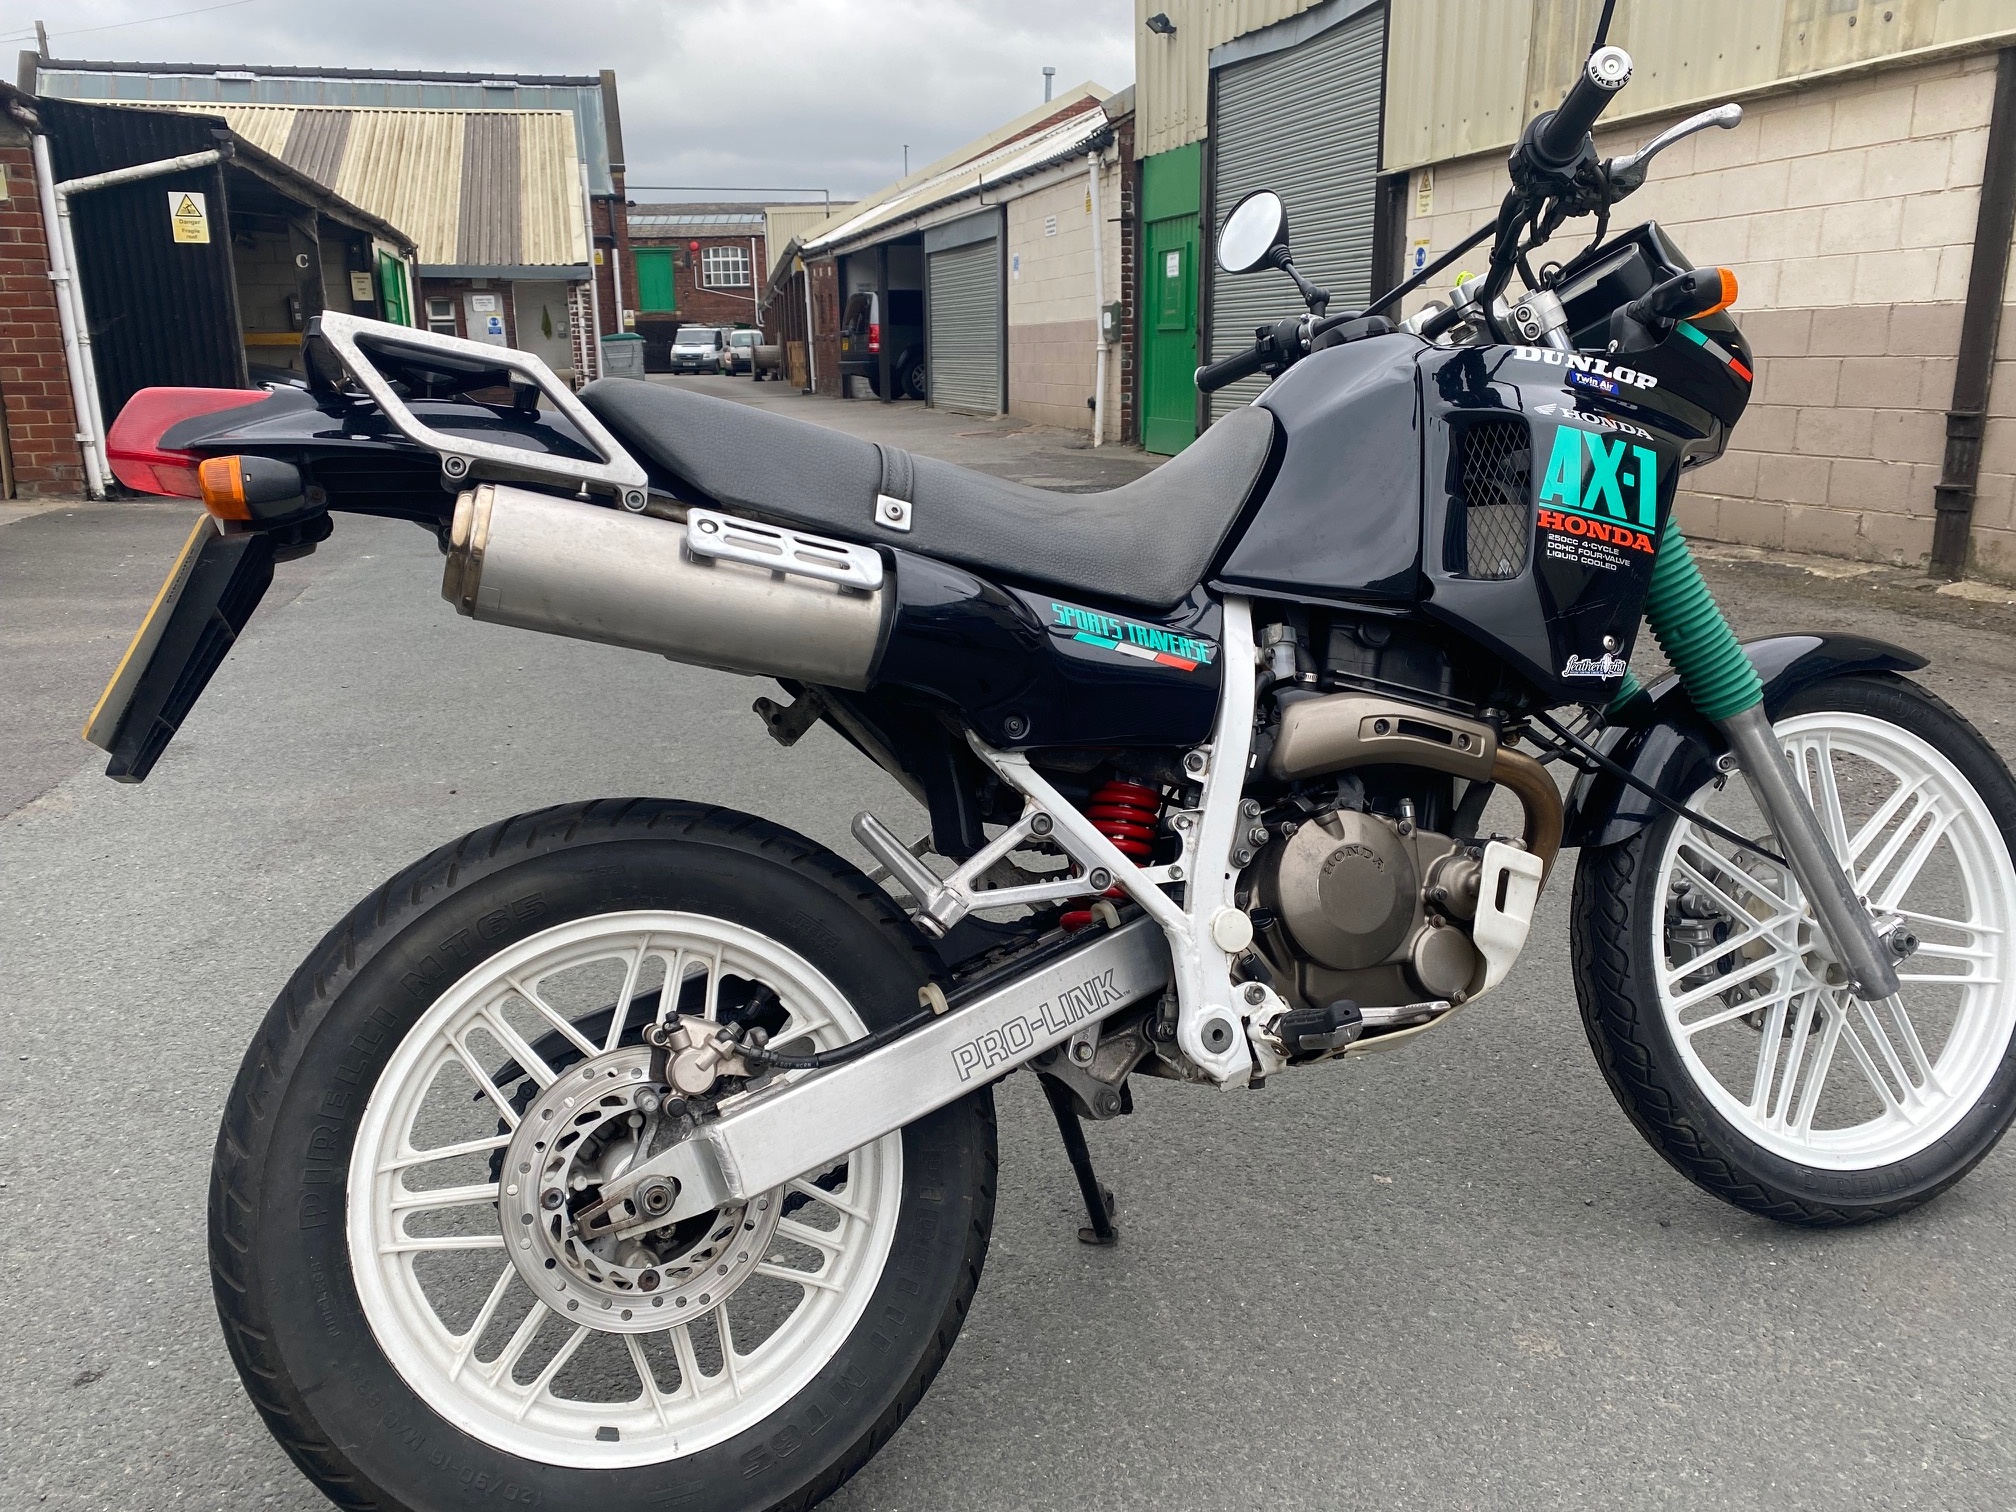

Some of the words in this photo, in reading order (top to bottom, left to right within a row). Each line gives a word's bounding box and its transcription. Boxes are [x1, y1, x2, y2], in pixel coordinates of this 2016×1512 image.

[1590, 65, 1633, 87] BIKETEK
[295, 253, 309, 268] C
[1513, 345, 1658, 390] DUNLOP
[1575, 372, 1599, 386] Twin
[1599, 381, 1614, 392] Air
[1559, 407, 1655, 442] HONDA
[1539, 424, 1658, 528] AX-1
[1537, 509, 1655, 555] HONDA
[1547, 541, 1576, 553] DOHC
[1548, 533, 1579, 546] 250CC
[1547, 549, 1578, 562] LIQUID
[1580, 556, 1617, 571] COOLED
[1051, 602, 1123, 640] SPORTS
[1125, 621, 1212, 665] TRAVERSE
[1322, 845, 1385, 879] HONDA
[950, 967, 1124, 1083] PRO-LINK
[299, 1005, 399, 1231] PIRELLI
[400, 891, 549, 998] MT65
[1796, 1164, 1917, 1199] PIRELLI
